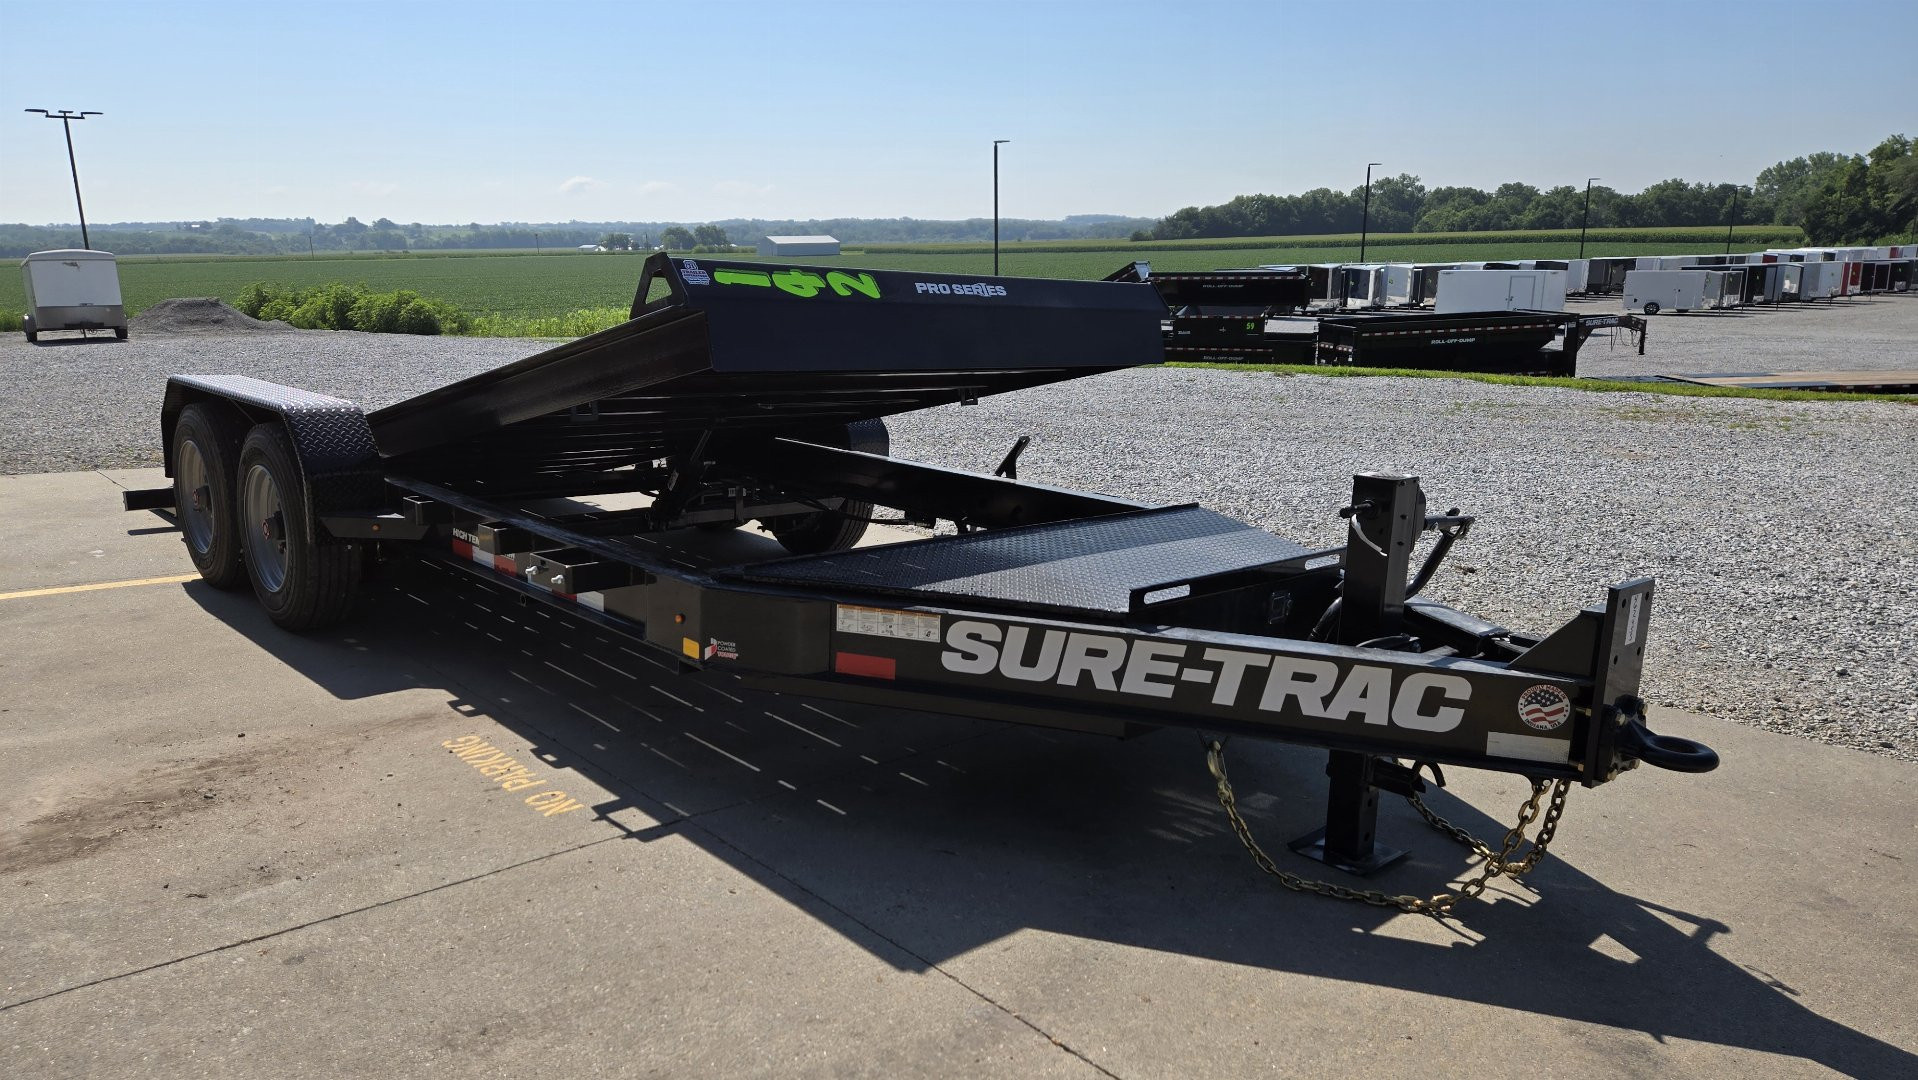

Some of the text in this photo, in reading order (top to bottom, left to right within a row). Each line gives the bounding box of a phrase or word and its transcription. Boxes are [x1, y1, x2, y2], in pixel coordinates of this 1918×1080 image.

[915, 282, 1007, 297] PRO SERIES
[1246, 322, 1255, 330] 59
[1585, 317, 1619, 326] SURE-TRAC
[452, 528, 468, 541] HIGH
[940, 620, 1473, 733] SURE-TRAC
[1521, 685, 1545, 699] PROUDLY
[441, 735, 584, 818] NO PARKING
